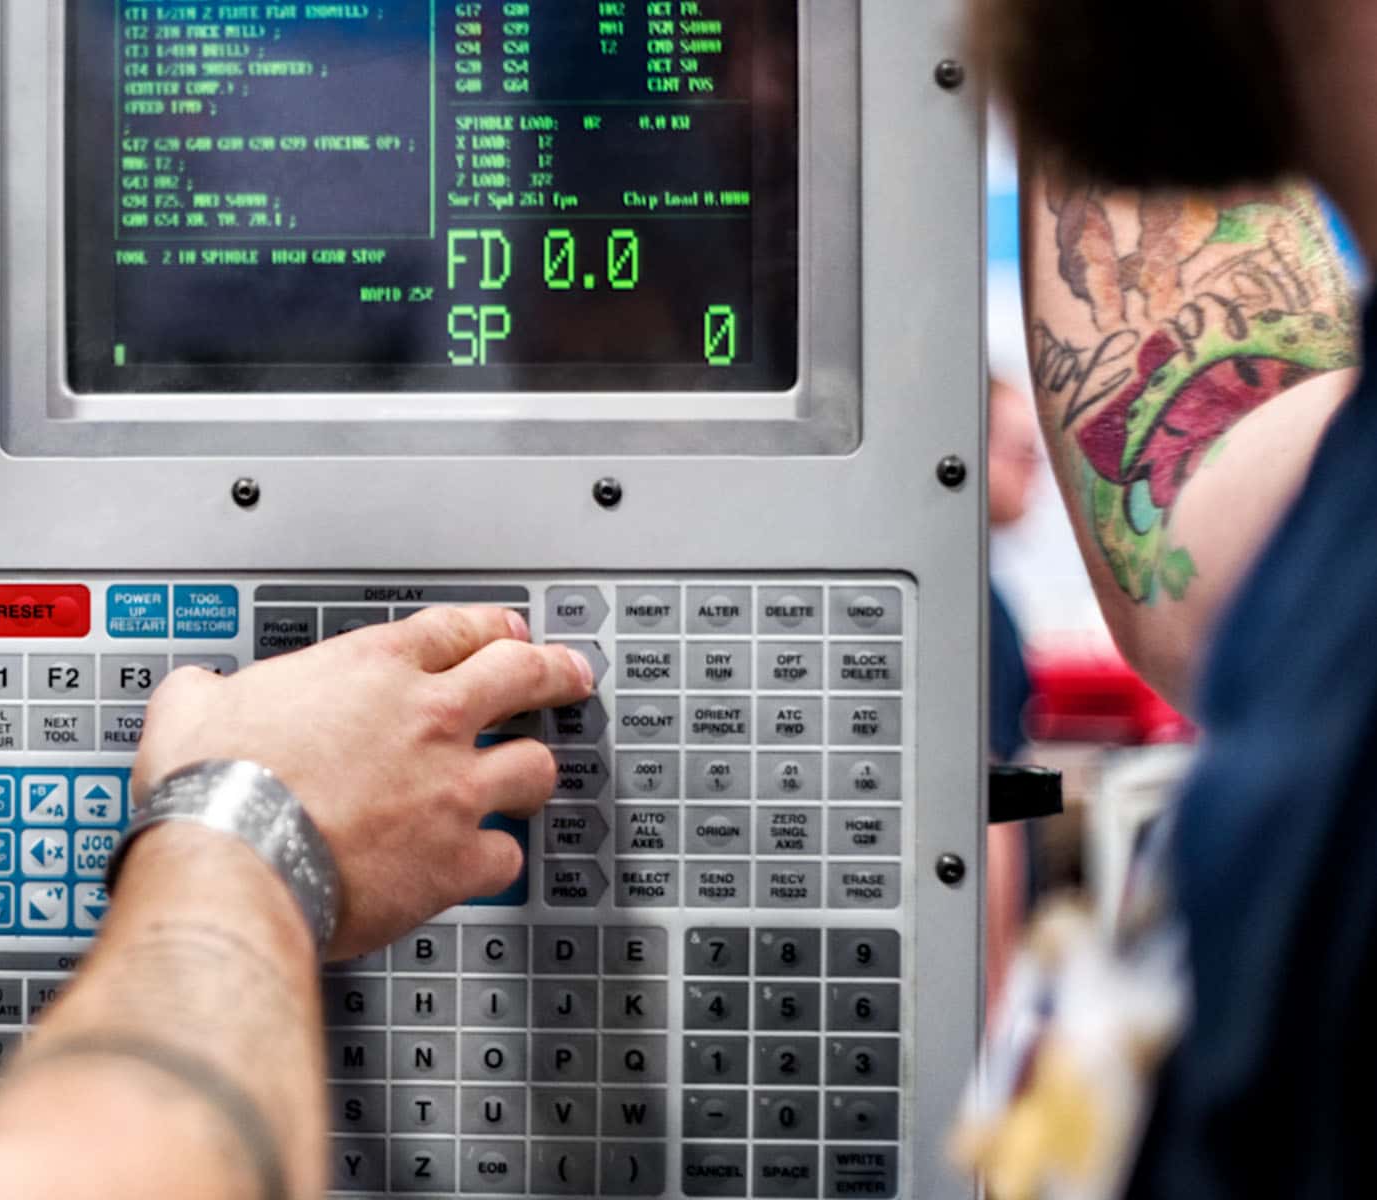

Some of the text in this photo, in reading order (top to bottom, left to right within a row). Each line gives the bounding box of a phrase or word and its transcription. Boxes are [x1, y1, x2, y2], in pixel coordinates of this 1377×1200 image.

[455, 115, 514, 130] SPINDLE
[623, 191, 659, 210] Chip
[664, 191, 698, 206] Load
[116, 249, 148, 265] TOOL
[162, 249, 171, 265] 2
[179, 249, 196, 265] IN
[201, 249, 258, 265] SPINDLE
[271, 249, 307, 264] HIGH
[352, 249, 386, 264] STOP
[448, 230, 639, 289] FD 0.0
[448, 305, 735, 365] SP 0
[114, 593, 161, 604] POWER
[189, 593, 222, 604] TOOL
[364, 589, 423, 600] DISPLAY
[129, 607, 146, 617] UP
[175, 607, 236, 617] CHANGER
[557, 606, 584, 616] EDIT
[626, 606, 670, 617] INSERT
[698, 606, 739, 617] ALTER
[766, 606, 814, 618] DELETE
[848, 606, 884, 618] UNDO
[110, 620, 167, 632] RESTART
[176, 621, 234, 632] RESTORE
[626, 654, 670, 666] SINGLE
[706, 654, 731, 665] DRY
[777, 654, 801, 666] OPT
[843, 655, 886, 666] BLOCK
[48, 667, 79, 688] F2
[120, 667, 152, 688] F3
[627, 667, 670, 679] BLOCK
[706, 667, 732, 679] RUN
[774, 668, 807, 680] STOP
[841, 668, 890, 680] DELETE
[695, 709, 740, 720] ORIENT
[777, 709, 802, 720] ATC
[852, 710, 877, 721] ATC
[44, 717, 78, 728] NEXT
[117, 717, 144, 728] TOO
[622, 715, 673, 727] COOLNT
[692, 722, 745, 734] SPINDLE
[776, 723, 804, 734] FWD
[853, 723, 878, 734] REV
[44, 731, 78, 742] TOOL
[558, 763, 599, 774] ANDLE
[552, 818, 586, 829] ZERO
[630, 813, 665, 824] AUTO
[772, 814, 807, 825] ZERO
[636, 826, 659, 837] ALL
[696, 826, 740, 837] ORIGIN
[846, 820, 882, 831] HOME
[770, 827, 808, 837] SINGL
[82, 836, 113, 850] JOG
[557, 833, 581, 844] RET
[630, 838, 664, 849] AXES
[775, 839, 804, 850] AXIS
[77, 855, 107, 869] LOC
[555, 872, 581, 883] LIST
[623, 873, 670, 883] SELECT
[700, 873, 734, 884] SEND
[771, 874, 805, 885] RECV
[842, 874, 885, 885] ERASE
[552, 887, 587, 898] PROG
[629, 886, 665, 898] PROG
[698, 886, 736, 898] RS232
[770, 887, 808, 898] RS232
[846, 888, 882, 899] PROG
[416, 939, 432, 958] B
[485, 939, 503, 959] C
[556, 940, 573, 960] D
[627, 941, 643, 961] E
[710, 942, 724, 962] 7
[781, 943, 796, 963] 8
[856, 944, 871, 964] 9
[344, 991, 364, 1013] G
[416, 993, 432, 1012] H
[491, 993, 496, 1013] I
[558, 994, 571, 1014] J
[626, 995, 643, 1015] K
[709, 996, 724, 1016] 4
[781, 997, 796, 1017] 5
[856, 998, 871, 1018] 6
[344, 1046, 364, 1066] M
[416, 1048, 432, 1067] N
[484, 1048, 503, 1068] O
[556, 1050, 571, 1069] P
[625, 1050, 644, 1071] Q
[712, 1052, 721, 1072] 1
[780, 1053, 795, 1072] 2
[855, 1053, 871, 1073] 3
[345, 1100, 362, 1120] S
[415, 1101, 431, 1121] T
[485, 1102, 502, 1122] U
[555, 1103, 572, 1123] V
[622, 1103, 646, 1123] W
[780, 1106, 794, 1127] 0
[345, 1155, 361, 1175] Y
[836, 1154, 885, 1166] WRITE
[415, 1157, 431, 1177] Z
[478, 1162, 507, 1173] EOB
[686, 1166, 743, 1178] CANCEL
[763, 1166, 809, 1178] SPACE
[836, 1181, 886, 1193] ENTER
